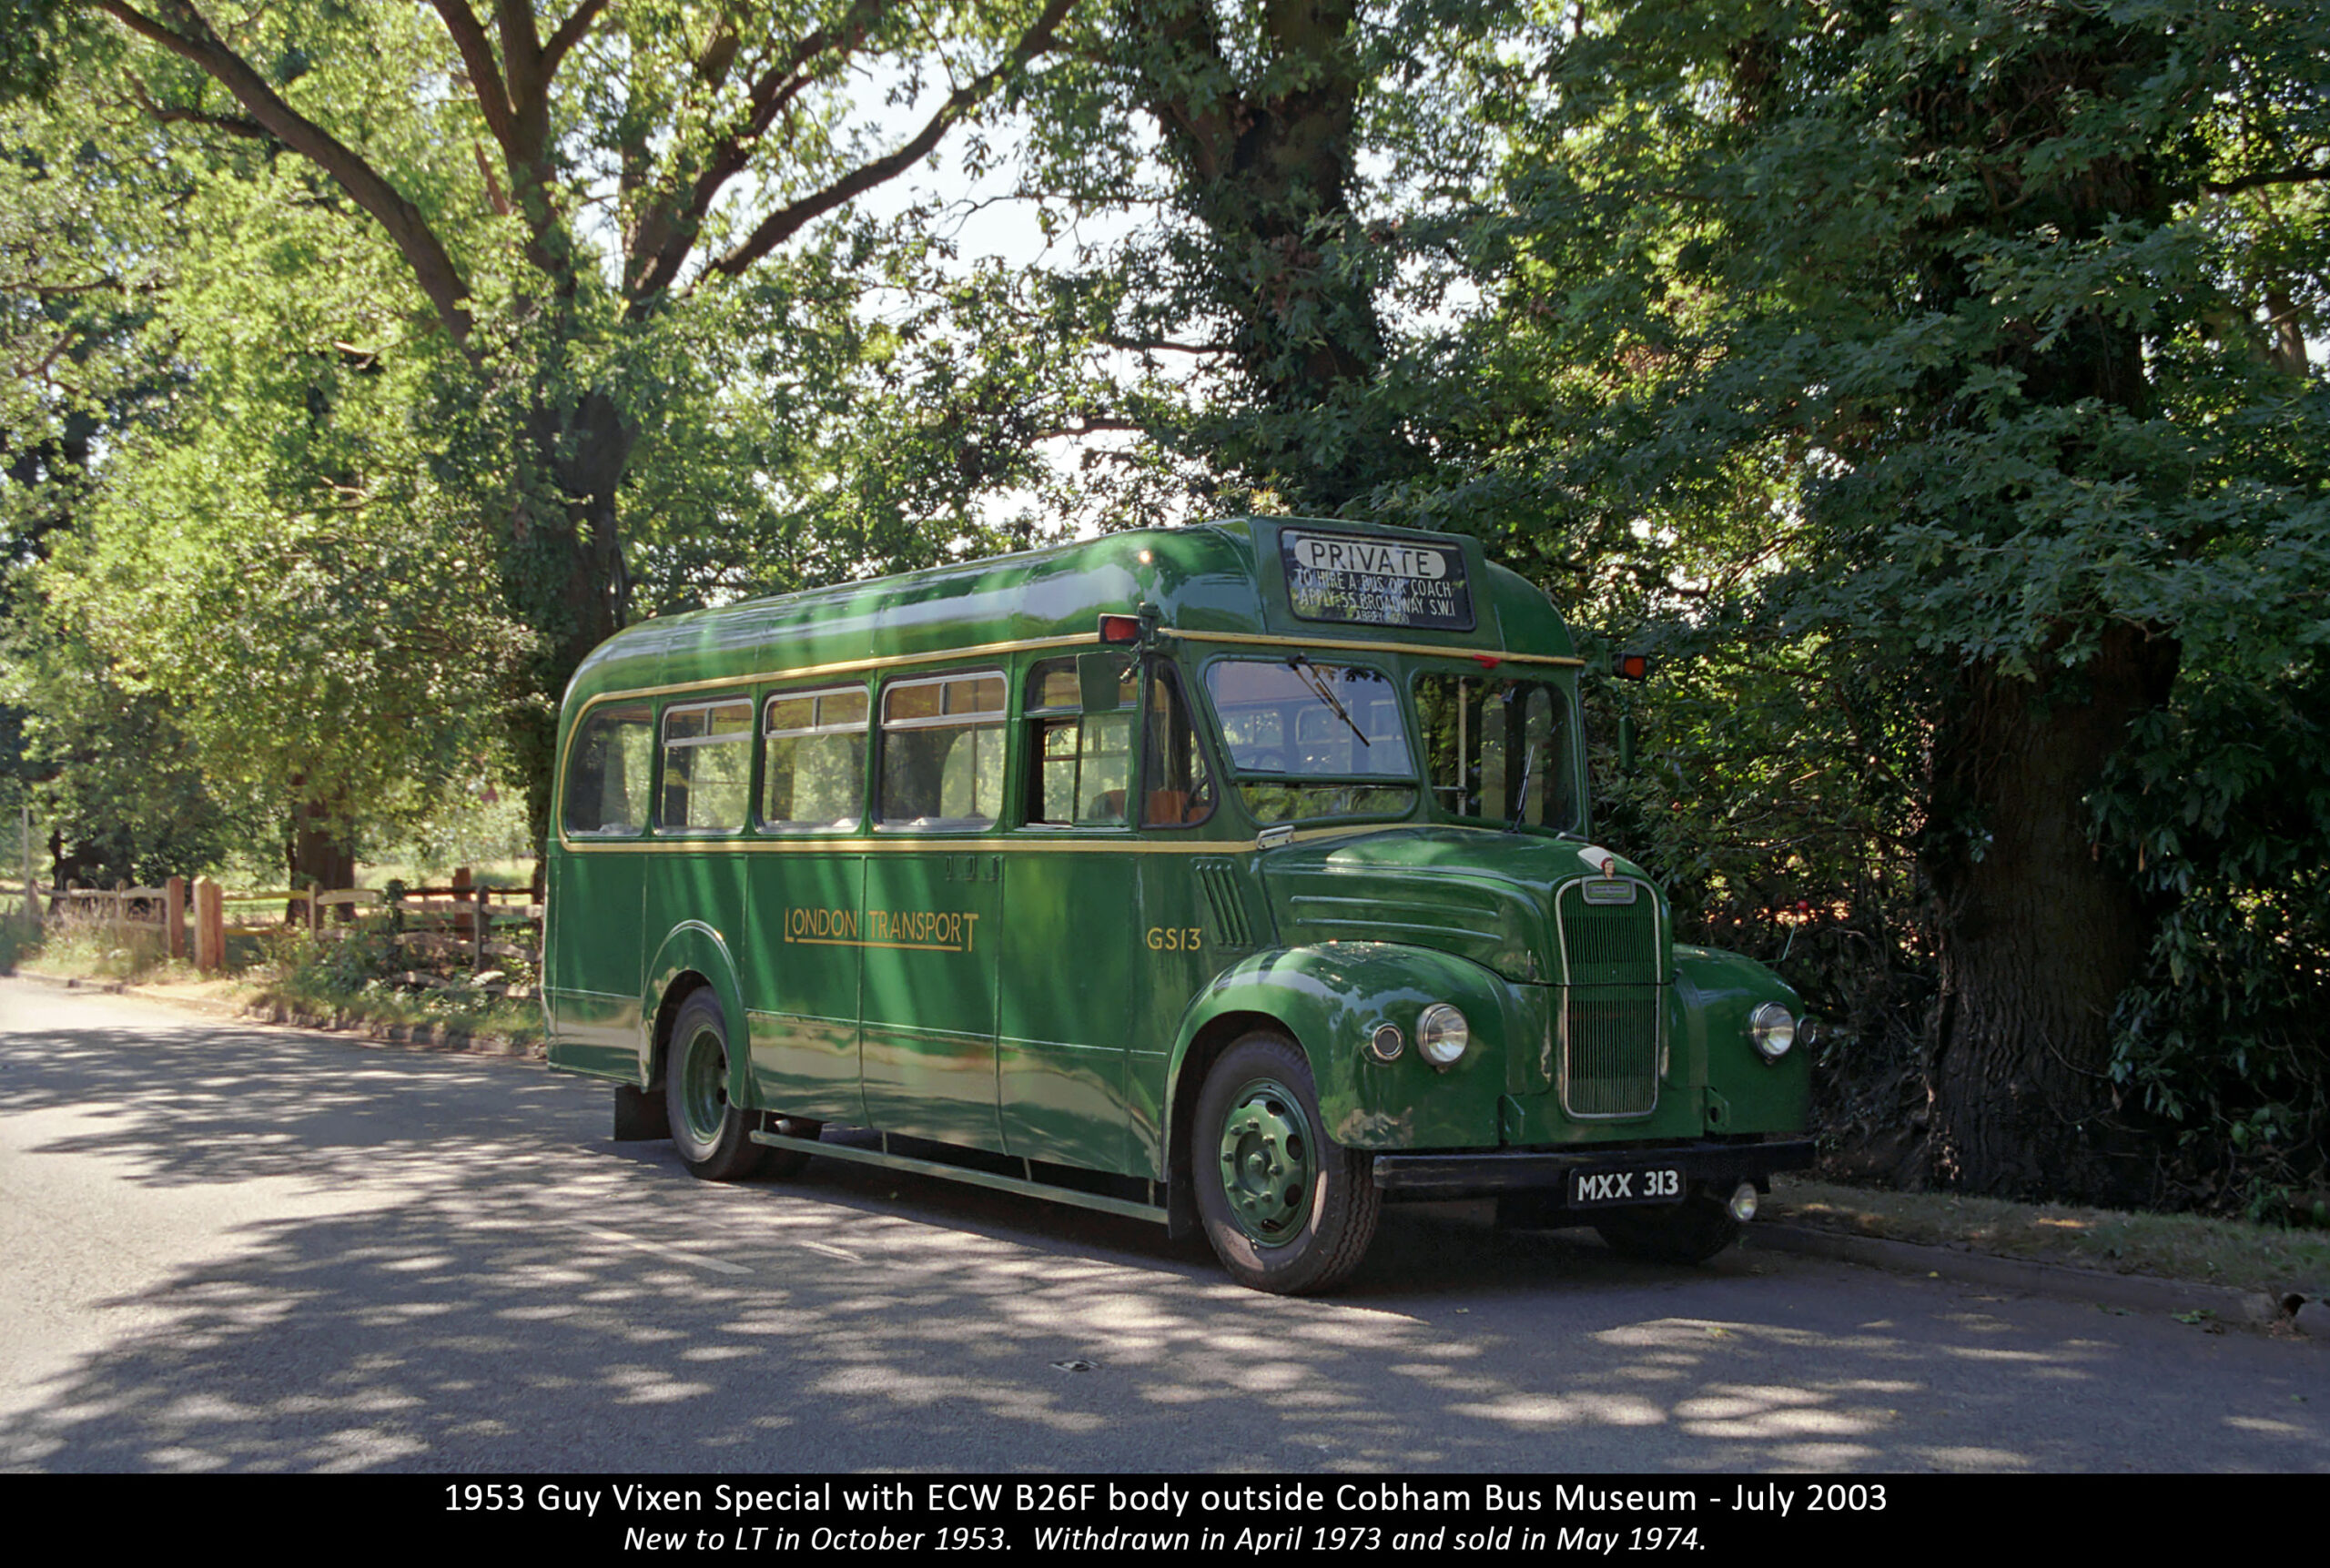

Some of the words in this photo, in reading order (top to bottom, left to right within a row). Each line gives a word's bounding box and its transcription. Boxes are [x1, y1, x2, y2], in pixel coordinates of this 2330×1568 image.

[1311, 541, 1432, 577] PRIVATE
[1293, 567, 1312, 587] TO
[1316, 571, 1345, 590] HIRE
[1349, 573, 1358, 591] A
[1361, 574, 1384, 593] BUS
[1388, 577, 1407, 595] OR
[1410, 579, 1453, 598] COACH
[1340, 592, 1357, 608] 55
[1360, 592, 1424, 615] BROADWAY
[784, 907, 858, 943] LONDON
[867, 910, 979, 953] TRANSPORT
[1147, 927, 1202, 952] GS13
[1577, 1172, 1634, 1201] MXX
[1643, 1169, 1679, 1197] 313
